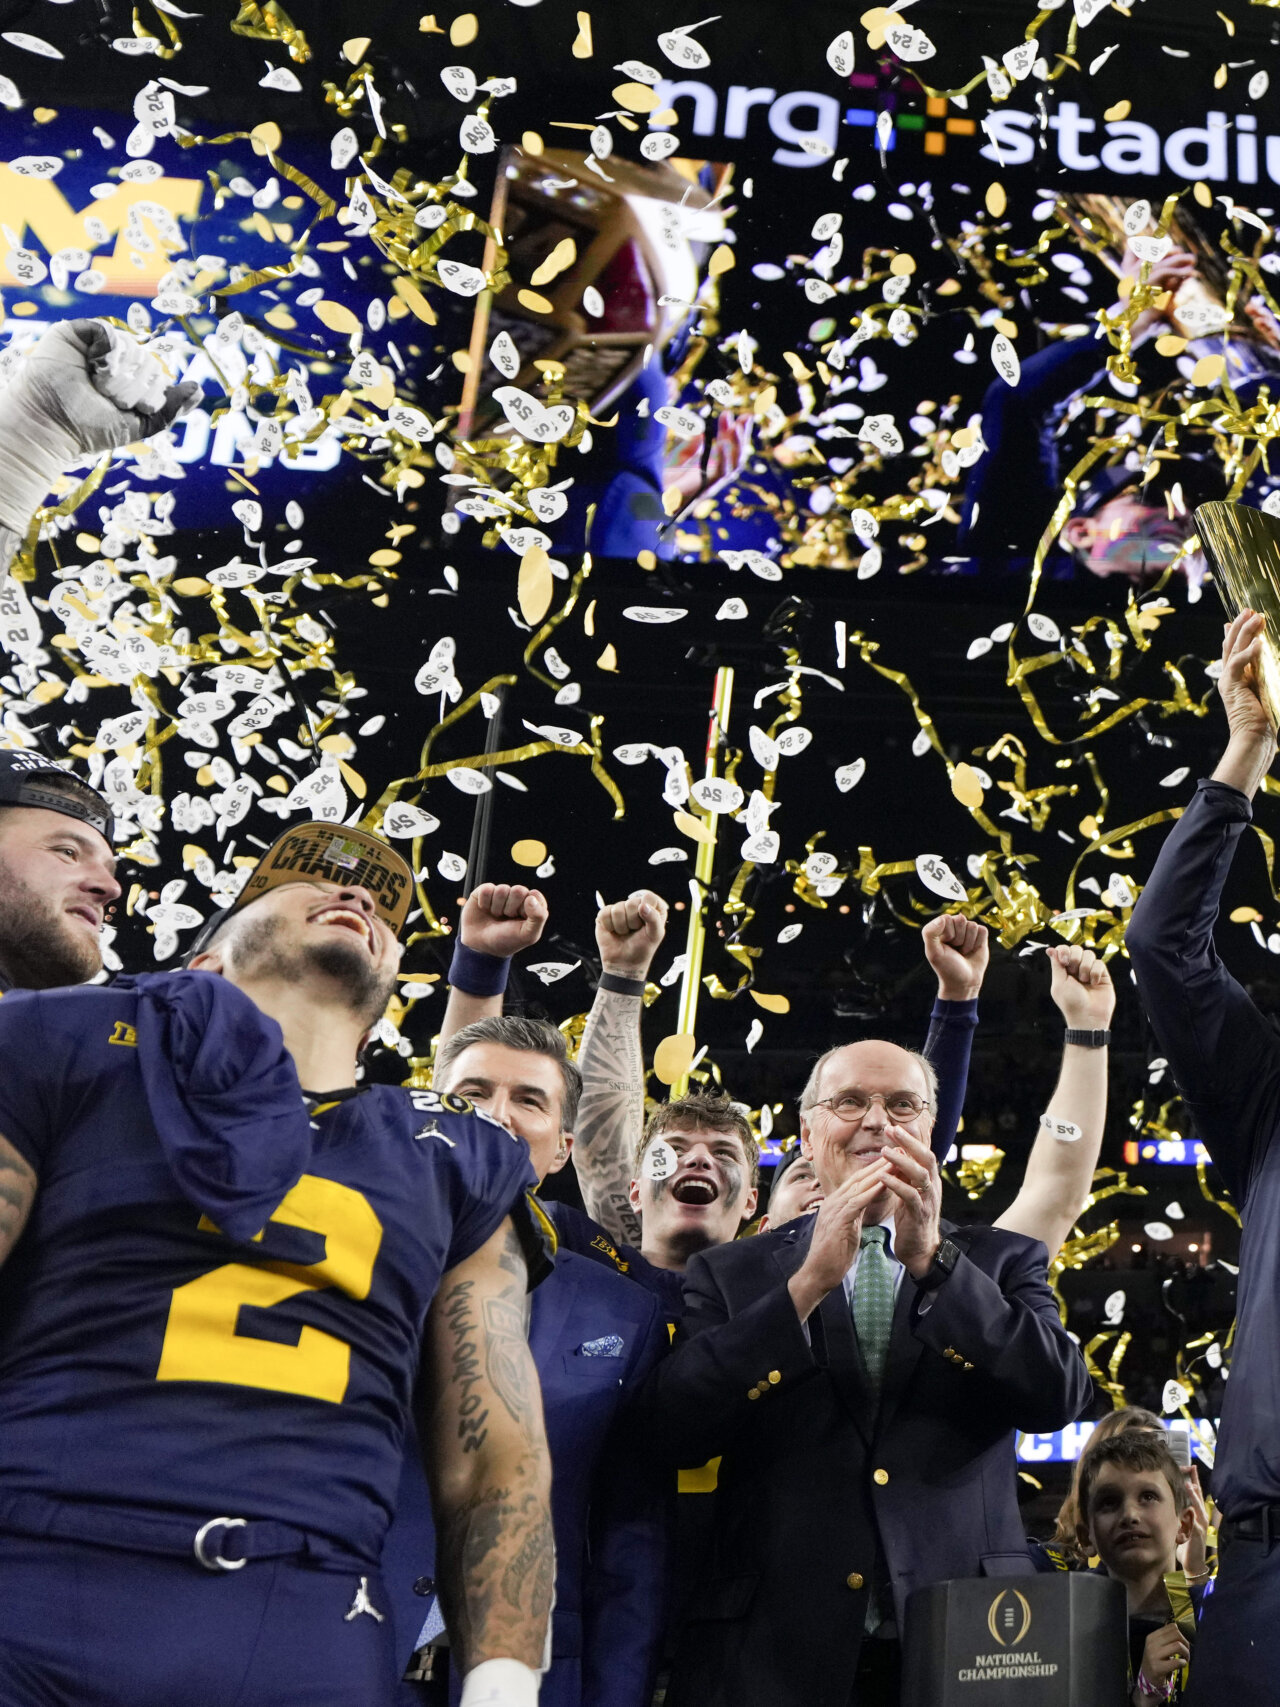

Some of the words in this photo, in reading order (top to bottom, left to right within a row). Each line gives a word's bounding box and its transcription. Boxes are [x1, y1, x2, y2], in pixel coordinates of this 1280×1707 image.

[648, 80, 841, 168] nrg
[157, 1174, 382, 1405] 2
[958, 1663, 1058, 1682] CHAMPIONSHIP
[975, 1651, 1042, 1668] NATIONAL
